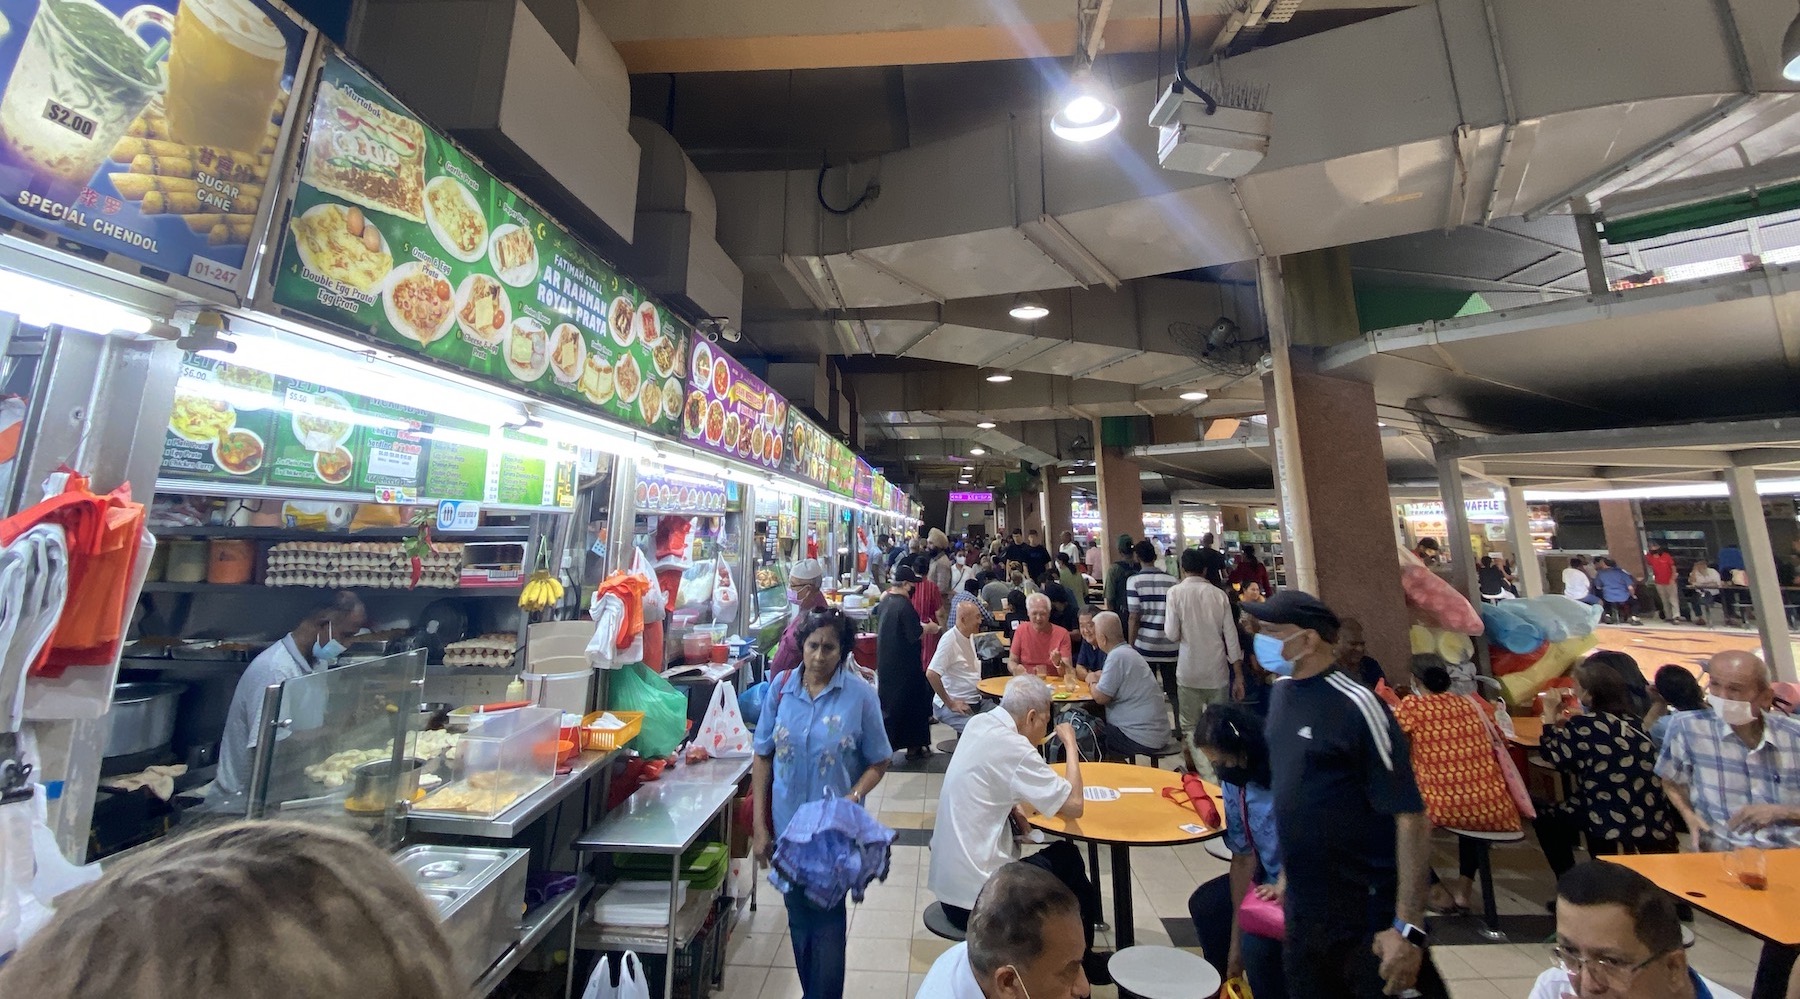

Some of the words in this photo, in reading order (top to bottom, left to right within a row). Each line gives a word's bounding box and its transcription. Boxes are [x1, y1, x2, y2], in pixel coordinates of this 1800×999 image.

[344, 84, 382, 119] Murtabak
[48, 104, 93, 136] $2.00
[196, 172, 239, 199] SUGAR
[197, 188, 231, 213] CANE
[18, 189, 87, 227] SPECIAL
[92, 219, 159, 253] CHENDOL
[194, 261, 237, 284] 01-247
[411, 246, 432, 264] Onion
[439, 260, 452, 274] Egg
[421, 264, 439, 280] Prata
[301, 267, 333, 289] Double
[335, 280, 350, 298] Egg
[554, 254, 585, 282] FATIMAH
[584, 275, 603, 295] STALL
[317, 290, 334, 305] Egg
[334, 296, 359, 313] Prata
[543, 265, 561, 289] AR
[563, 277, 607, 317] RAHMAN
[537, 283, 574, 318] ROYAL
[576, 306, 607, 337] PRATA
[472, 346, 487, 360] Prata
[183, 368, 206, 380] $6.00
[1464, 500, 1499, 511] WAFFLE
